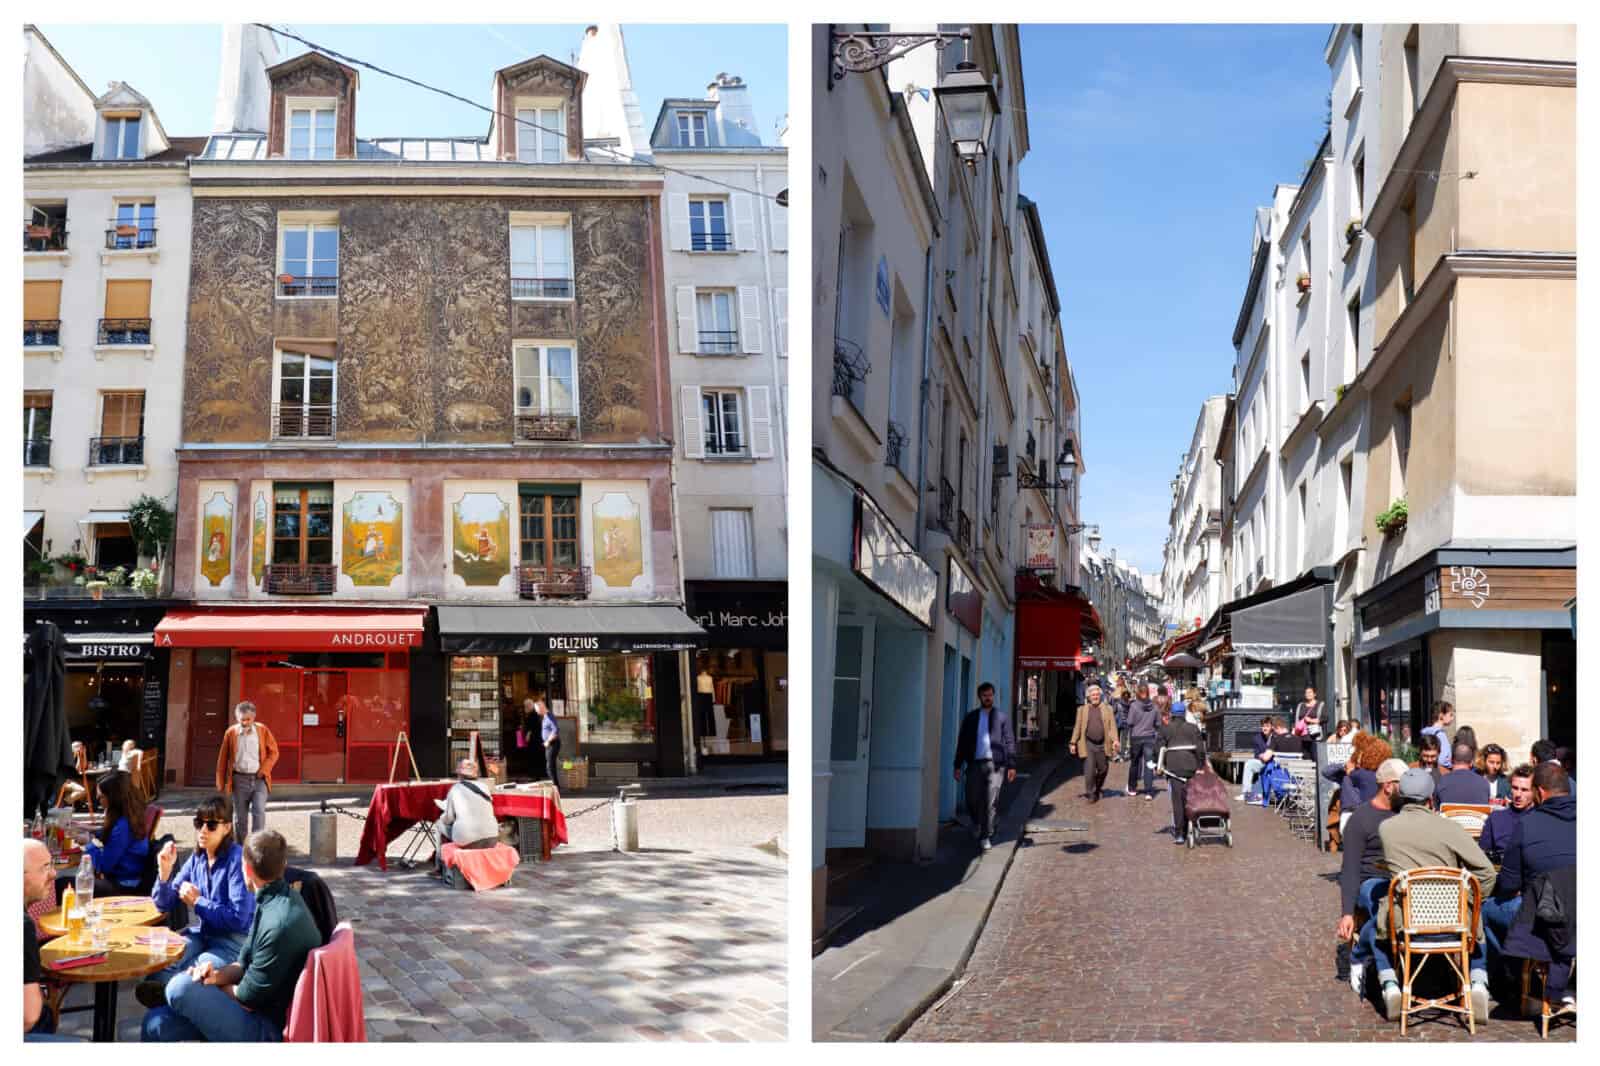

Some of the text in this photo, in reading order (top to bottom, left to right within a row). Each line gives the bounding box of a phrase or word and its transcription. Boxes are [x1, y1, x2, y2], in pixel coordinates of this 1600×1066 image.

[719, 611, 758, 626] Marc
[162, 633, 173, 645] A
[331, 633, 416, 645] ANDROUET
[549, 637, 599, 649] DELIZIUS
[81, 645, 141, 656] BISTRO
